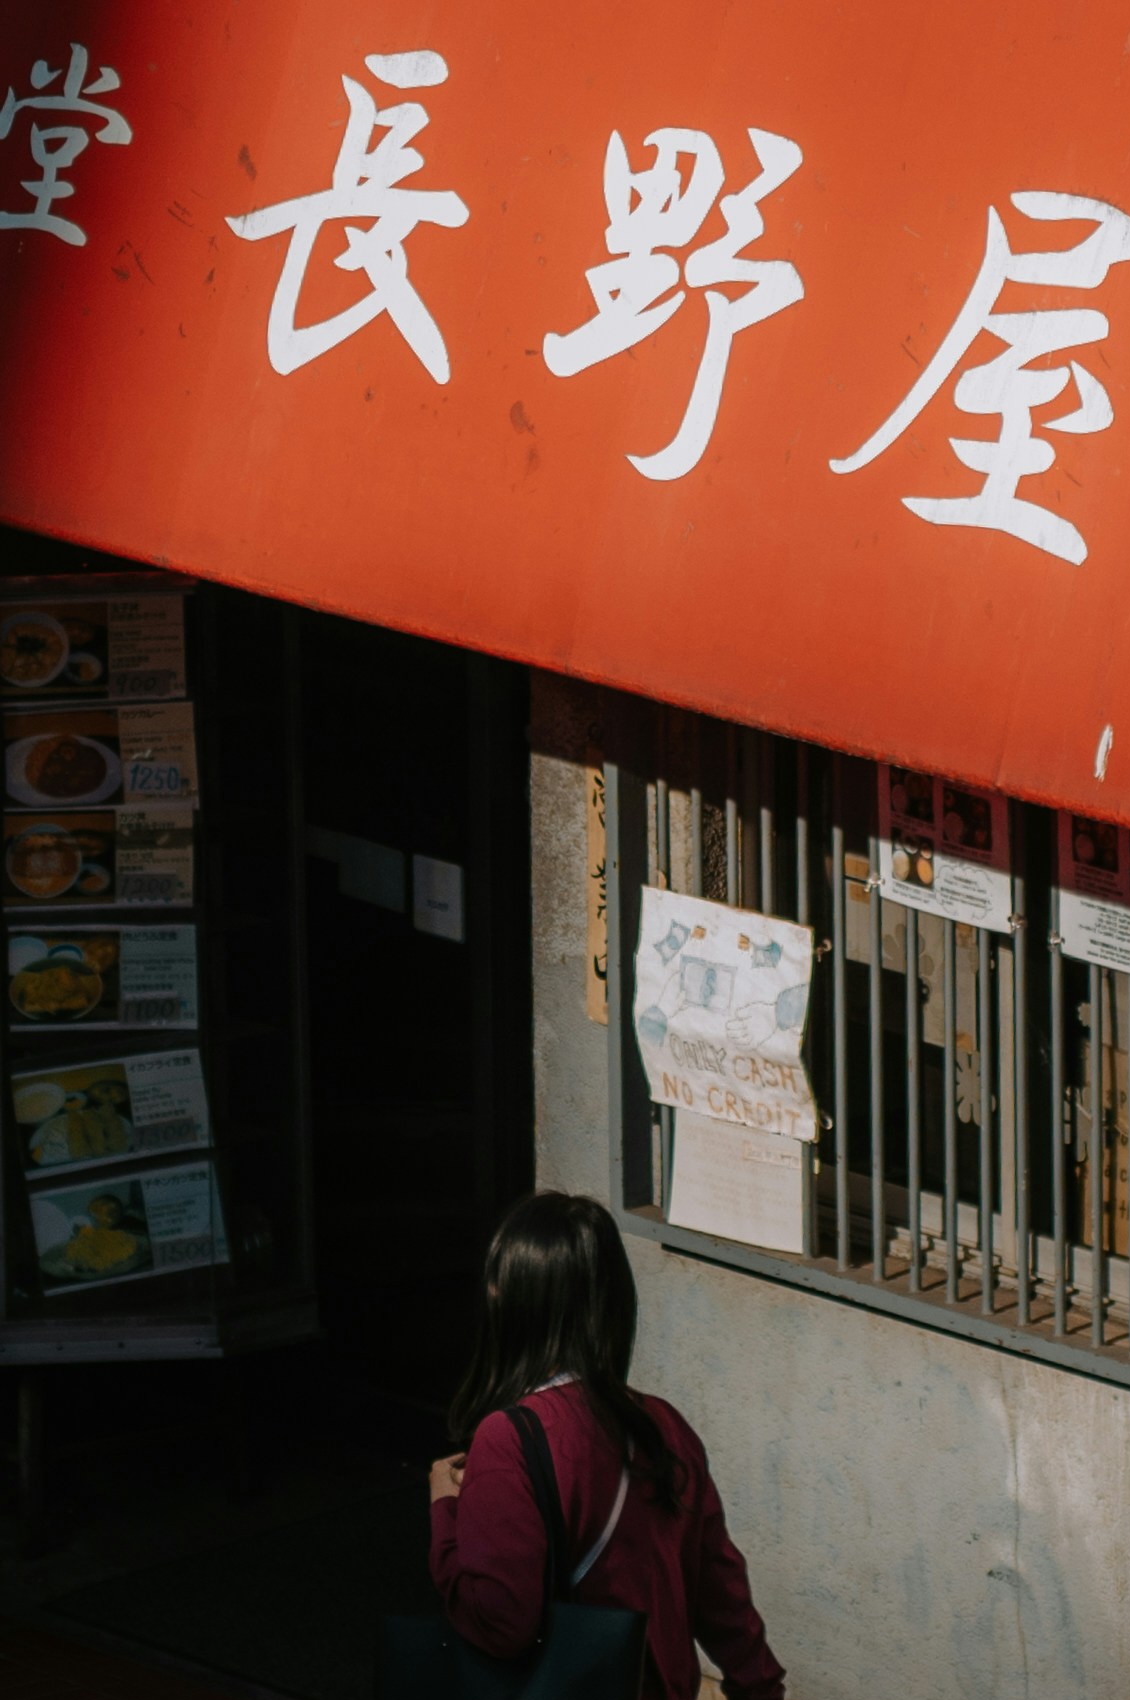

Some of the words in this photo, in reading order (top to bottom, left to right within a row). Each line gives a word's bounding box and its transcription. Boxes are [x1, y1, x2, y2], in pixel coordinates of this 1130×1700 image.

[0, 43, 132, 247] 堂
[116, 673, 157, 694] 900
[130, 763, 179, 791] 1250
[669, 1033, 727, 1076] ONLY
[733, 1055, 799, 1094] CASH
[662, 1071, 693, 1106] NO
